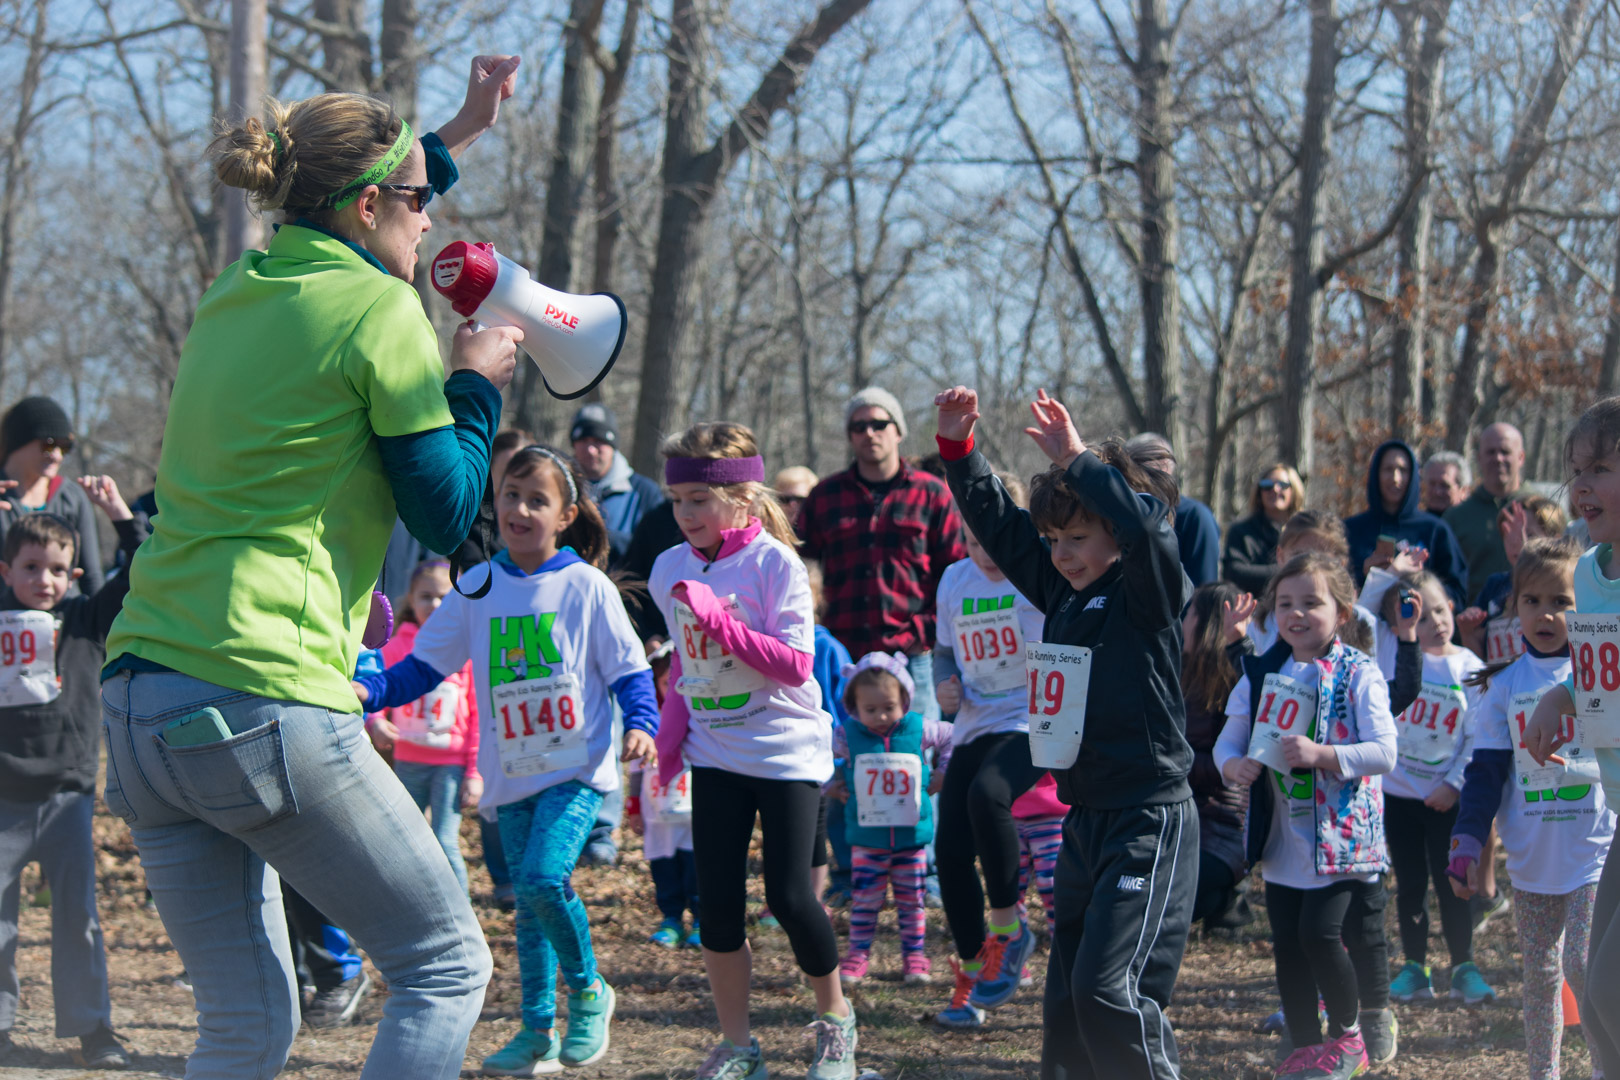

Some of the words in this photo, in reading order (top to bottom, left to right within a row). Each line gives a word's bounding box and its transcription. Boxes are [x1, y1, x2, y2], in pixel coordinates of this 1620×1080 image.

[724, 602, 739, 611] eries
[490, 612, 563, 668] HK
[683, 623, 731, 660] 87
[1574, 621, 1595, 636] Running
[1596, 621, 1618, 633] Series
[1, 629, 36, 666] 99
[960, 626, 1018, 662] 1039
[1034, 651, 1056, 665] Running
[1058, 652, 1082, 665] Series
[1274, 679, 1296, 695] Running
[1296, 686, 1315, 702] Series
[500, 694, 576, 740] 1148
[865, 768, 911, 797] 783
[1556, 807, 1582, 815] RUNNING
[1117, 875, 1145, 890] NIKE
